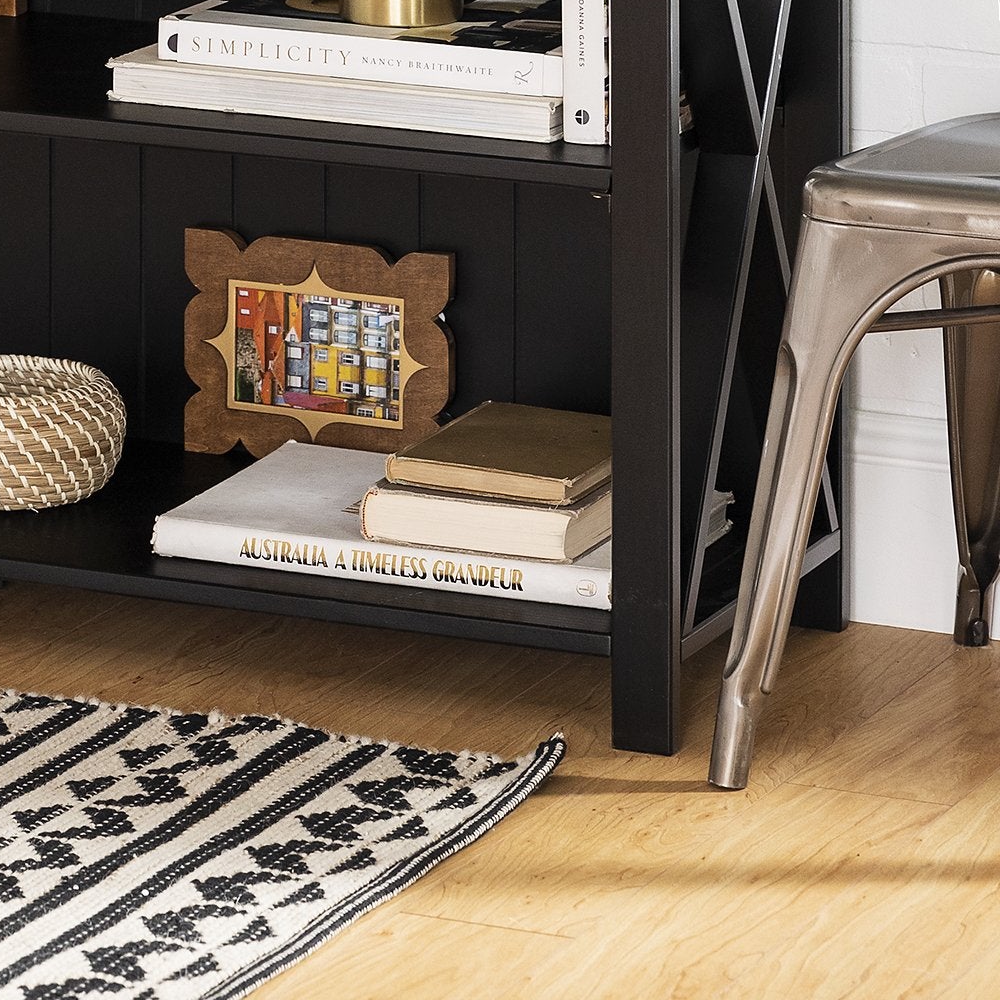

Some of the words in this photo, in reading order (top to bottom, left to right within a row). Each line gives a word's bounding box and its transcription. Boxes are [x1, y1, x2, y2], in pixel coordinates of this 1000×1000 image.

[192, 36, 351, 66] SIMPLICITY
[361, 56, 402, 68] NANCY
[408, 60, 494, 76] BRAITHWAITE
[239, 536, 329, 568] AUSTRALIA
[334, 549, 347, 570] A
[351, 549, 428, 580] TIMELESS
[432, 559, 524, 592] GRANDEUR
